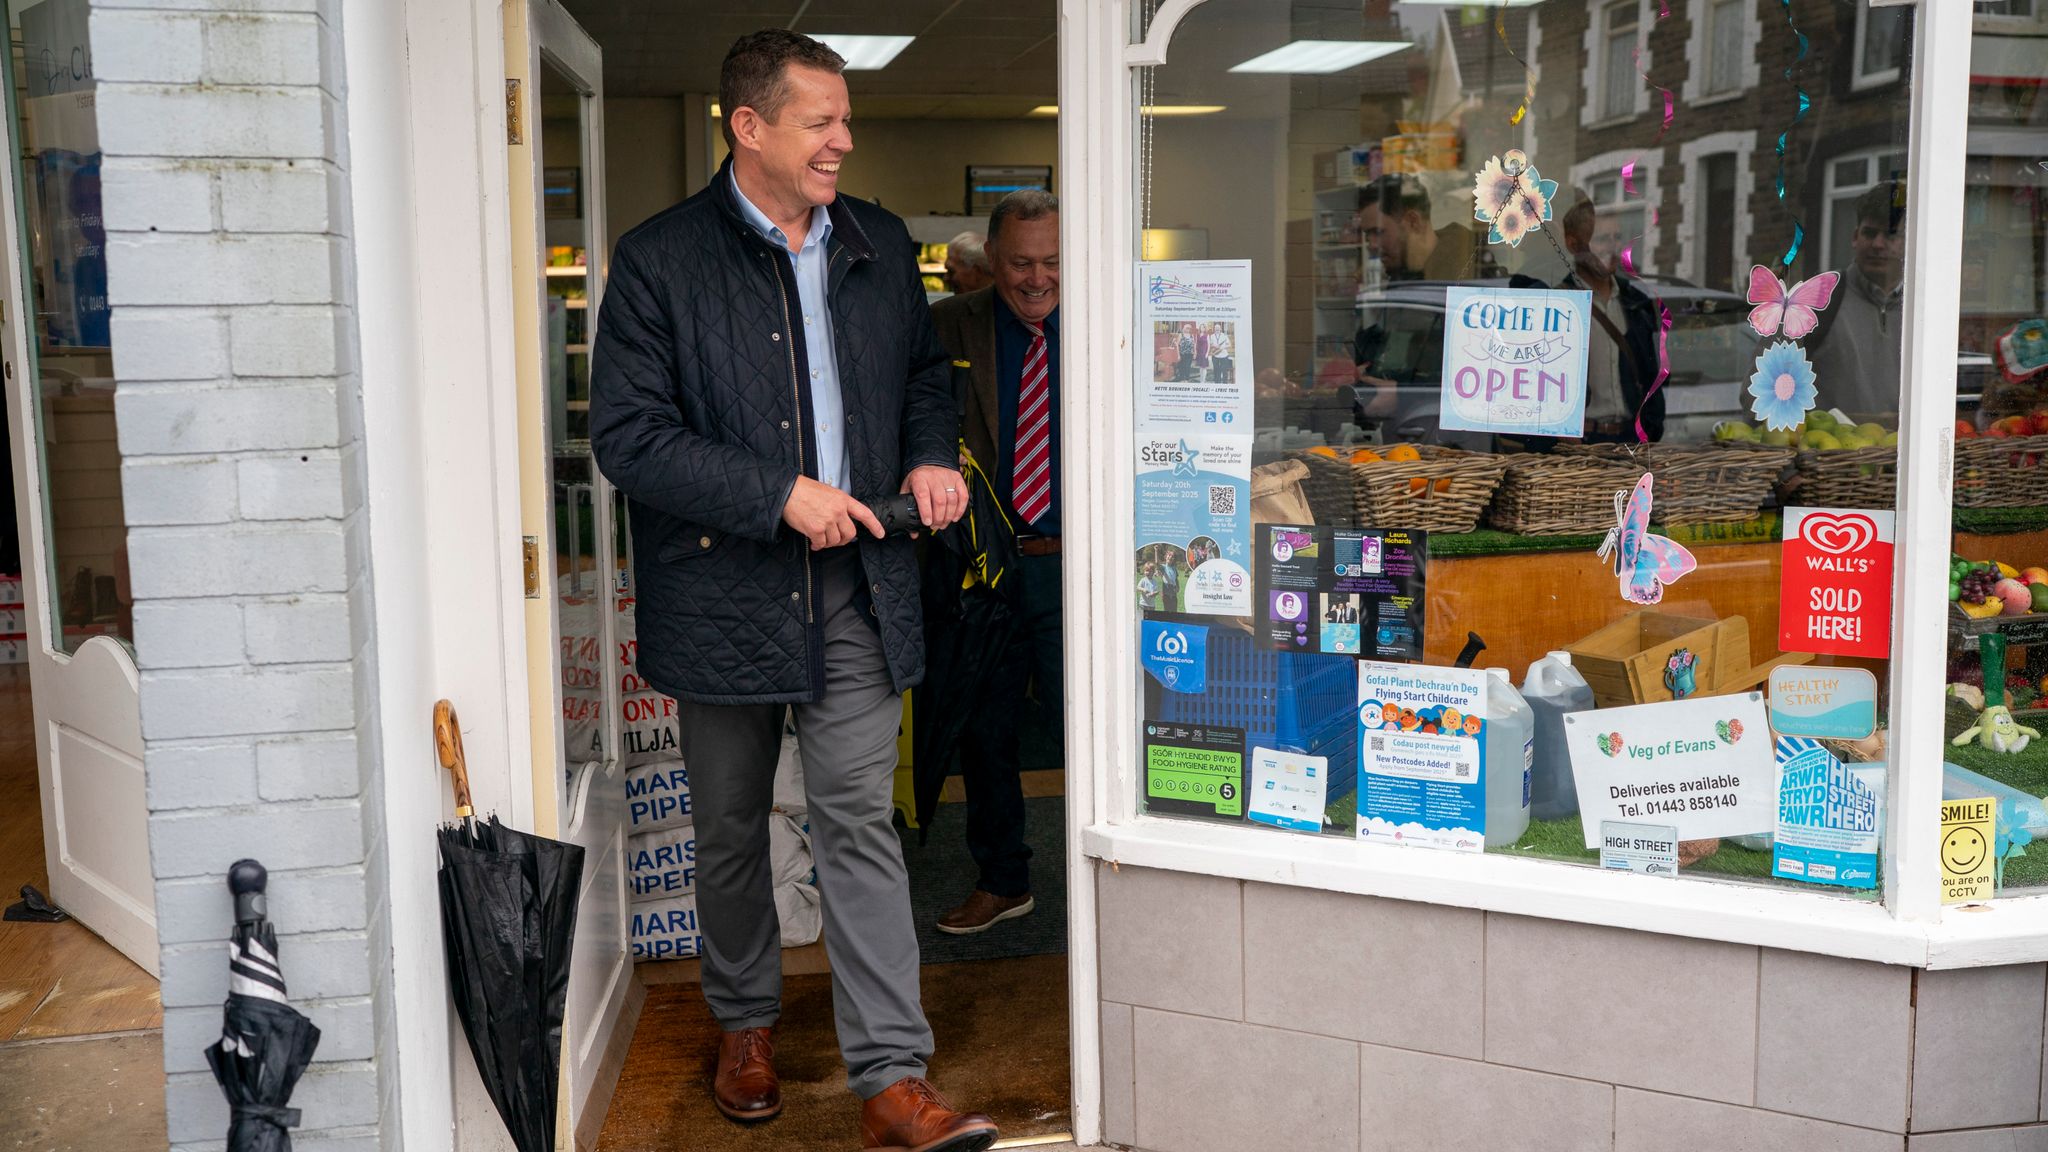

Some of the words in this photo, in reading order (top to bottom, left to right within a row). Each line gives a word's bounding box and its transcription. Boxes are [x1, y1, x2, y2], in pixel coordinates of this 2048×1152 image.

[1462, 301, 1534, 331] COME
[1543, 307, 1572, 333] IN
[1488, 338, 1510, 356] WE
[1513, 343, 1545, 360] ARE
[1454, 366, 1566, 403] OPEN
[1141, 446, 1183, 462] Stars
[1142, 480, 1173, 489] Saturday
[1142, 490, 1179, 498] September
[1806, 556, 1869, 573] WALL'S
[1203, 592, 1223, 600] insight
[1809, 586, 1862, 612] SOLD
[1808, 615, 1862, 642] HERE!
[1150, 654, 1194, 664] TheMusicLicence
[1366, 674, 1389, 686] Gofal
[1390, 676, 1413, 688] Plant
[1415, 679, 1458, 692] Dechrau'n
[1461, 683, 1478, 696] Deg
[1778, 679, 1839, 692] HEALTHY
[1375, 688, 1402, 702] Flying
[1404, 690, 1425, 701] Start
[1427, 692, 1468, 705] Childcare
[1785, 693, 1832, 705] START
[623, 698, 656, 722] ON
[662, 698, 678, 717] F
[623, 727, 677, 754] ILJA
[1392, 738, 1413, 748] Codau
[1415, 741, 1430, 750] post
[1431, 743, 1461, 753] newydd!
[1628, 745, 1653, 760] Veg
[1657, 742, 1670, 755] of
[1675, 739, 1716, 754] Evans
[1152, 748, 1173, 758] SGÔR
[1174, 751, 1211, 762] HYLENDID
[1213, 754, 1237, 764] BWYD
[1152, 758, 1175, 768] FOOD
[1176, 760, 1208, 771] HYGIENE
[1209, 763, 1237, 774] RATING
[1376, 754, 1391, 763] New
[1392, 756, 1426, 767] Postcodes
[1426, 759, 1451, 769] Added!
[625, 769, 689, 799] MAR
[1609, 782, 1676, 799] Deliveries
[1679, 774, 1740, 792] available
[1780, 763, 1827, 790] ARWR
[1830, 757, 1875, 800] HIGH
[1223, 785, 1232, 798] 5
[1779, 785, 1826, 805] STRYD
[1828, 784, 1874, 813] STREET
[630, 793, 693, 825] PIPE
[1618, 802, 1643, 817] Tel.
[1646, 799, 1686, 815] 01443
[1690, 793, 1738, 810] 858140
[1779, 804, 1825, 827] FAWR
[1827, 801, 1874, 831] HERO
[1941, 803, 1990, 822] SMILE!
[628, 839, 696, 872] ARIS
[1605, 836, 1630, 849] HIGH
[1633, 838, 1673, 853] STREET
[630, 867, 697, 895] IPER
[1941, 876, 1955, 886] ou
[1957, 877, 1974, 885] are
[1976, 876, 1990, 884] on
[1948, 887, 1978, 898] CCTV
[631, 910, 696, 937] MARI
[632, 935, 703, 958] PIPE
